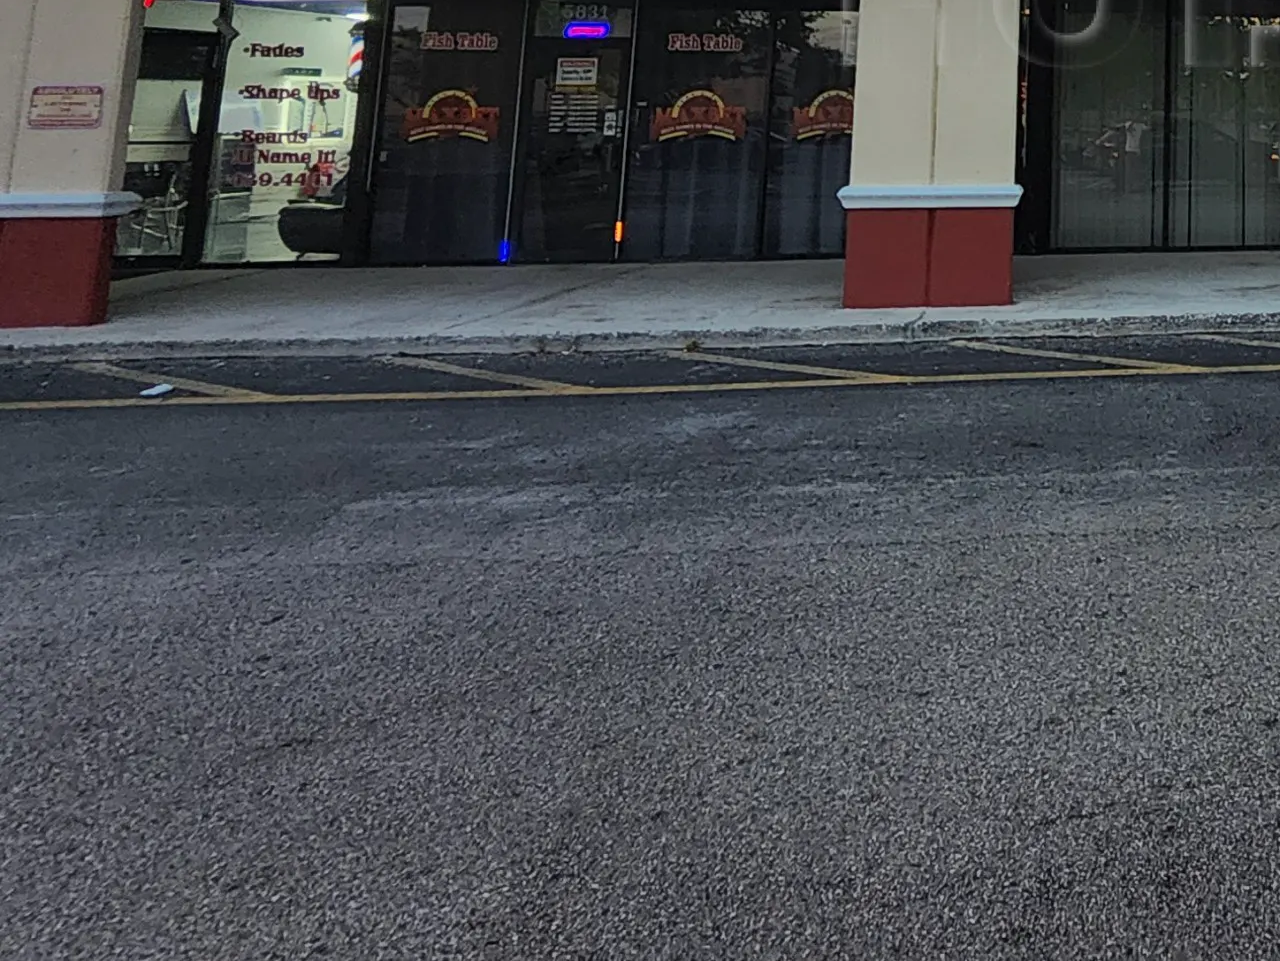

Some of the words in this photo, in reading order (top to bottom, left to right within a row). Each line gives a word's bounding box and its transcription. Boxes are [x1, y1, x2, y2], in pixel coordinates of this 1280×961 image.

[562, 4, 608, 19] 5831
[421, 32, 454, 50] Fish
[456, 32, 498, 50] Table
[668, 33, 701, 51] Fish
[702, 34, 742, 51] Table
[249, 43, 304, 57] Fades
[243, 85, 301, 103] Shape
[241, 130, 308, 144] Beards
[257, 149, 312, 164] Name
